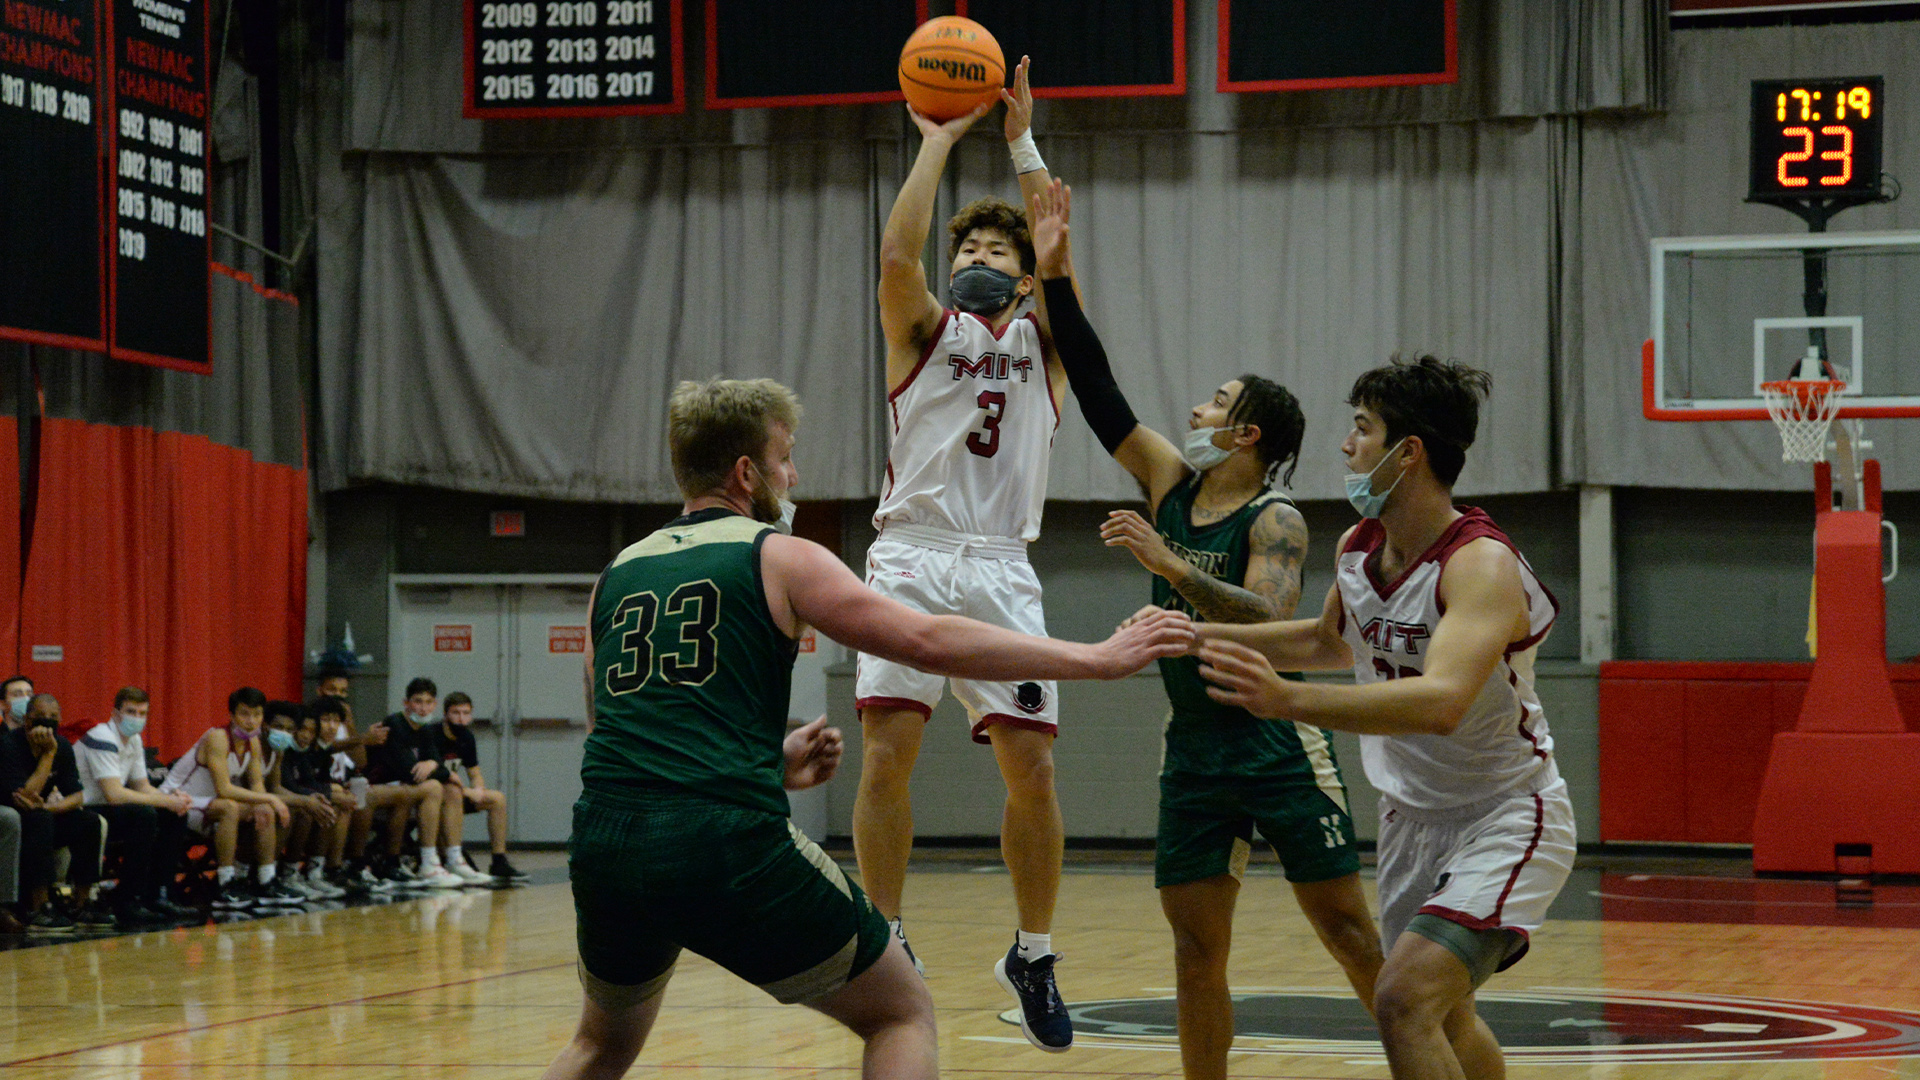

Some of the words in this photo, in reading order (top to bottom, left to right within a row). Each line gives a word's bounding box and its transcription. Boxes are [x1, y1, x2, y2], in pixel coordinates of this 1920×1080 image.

[482, 2, 538, 28] 2009
[546, 1, 597, 27] 2010
[606, 0, 653, 26] 2011
[482, 38, 533, 65] 2012
[546, 37, 597, 63] 2013
[605, 34, 655, 61] 2014
[483, 74, 535, 100] 2015
[546, 73, 599, 99] 2016
[605, 71, 654, 97] 2017
[917, 56, 987, 83] Wilson
[62, 89, 91, 125] 2019
[1777, 86, 1871, 122] 17:19
[1777, 125, 1853, 187] 23
[118, 187, 146, 221] 2015
[150, 195, 176, 230] 2016
[948, 351, 1033, 383] MIT
[965, 389, 1006, 459] 3
[605, 578, 722, 697] 33
[1361, 616, 1431, 655] MIT
